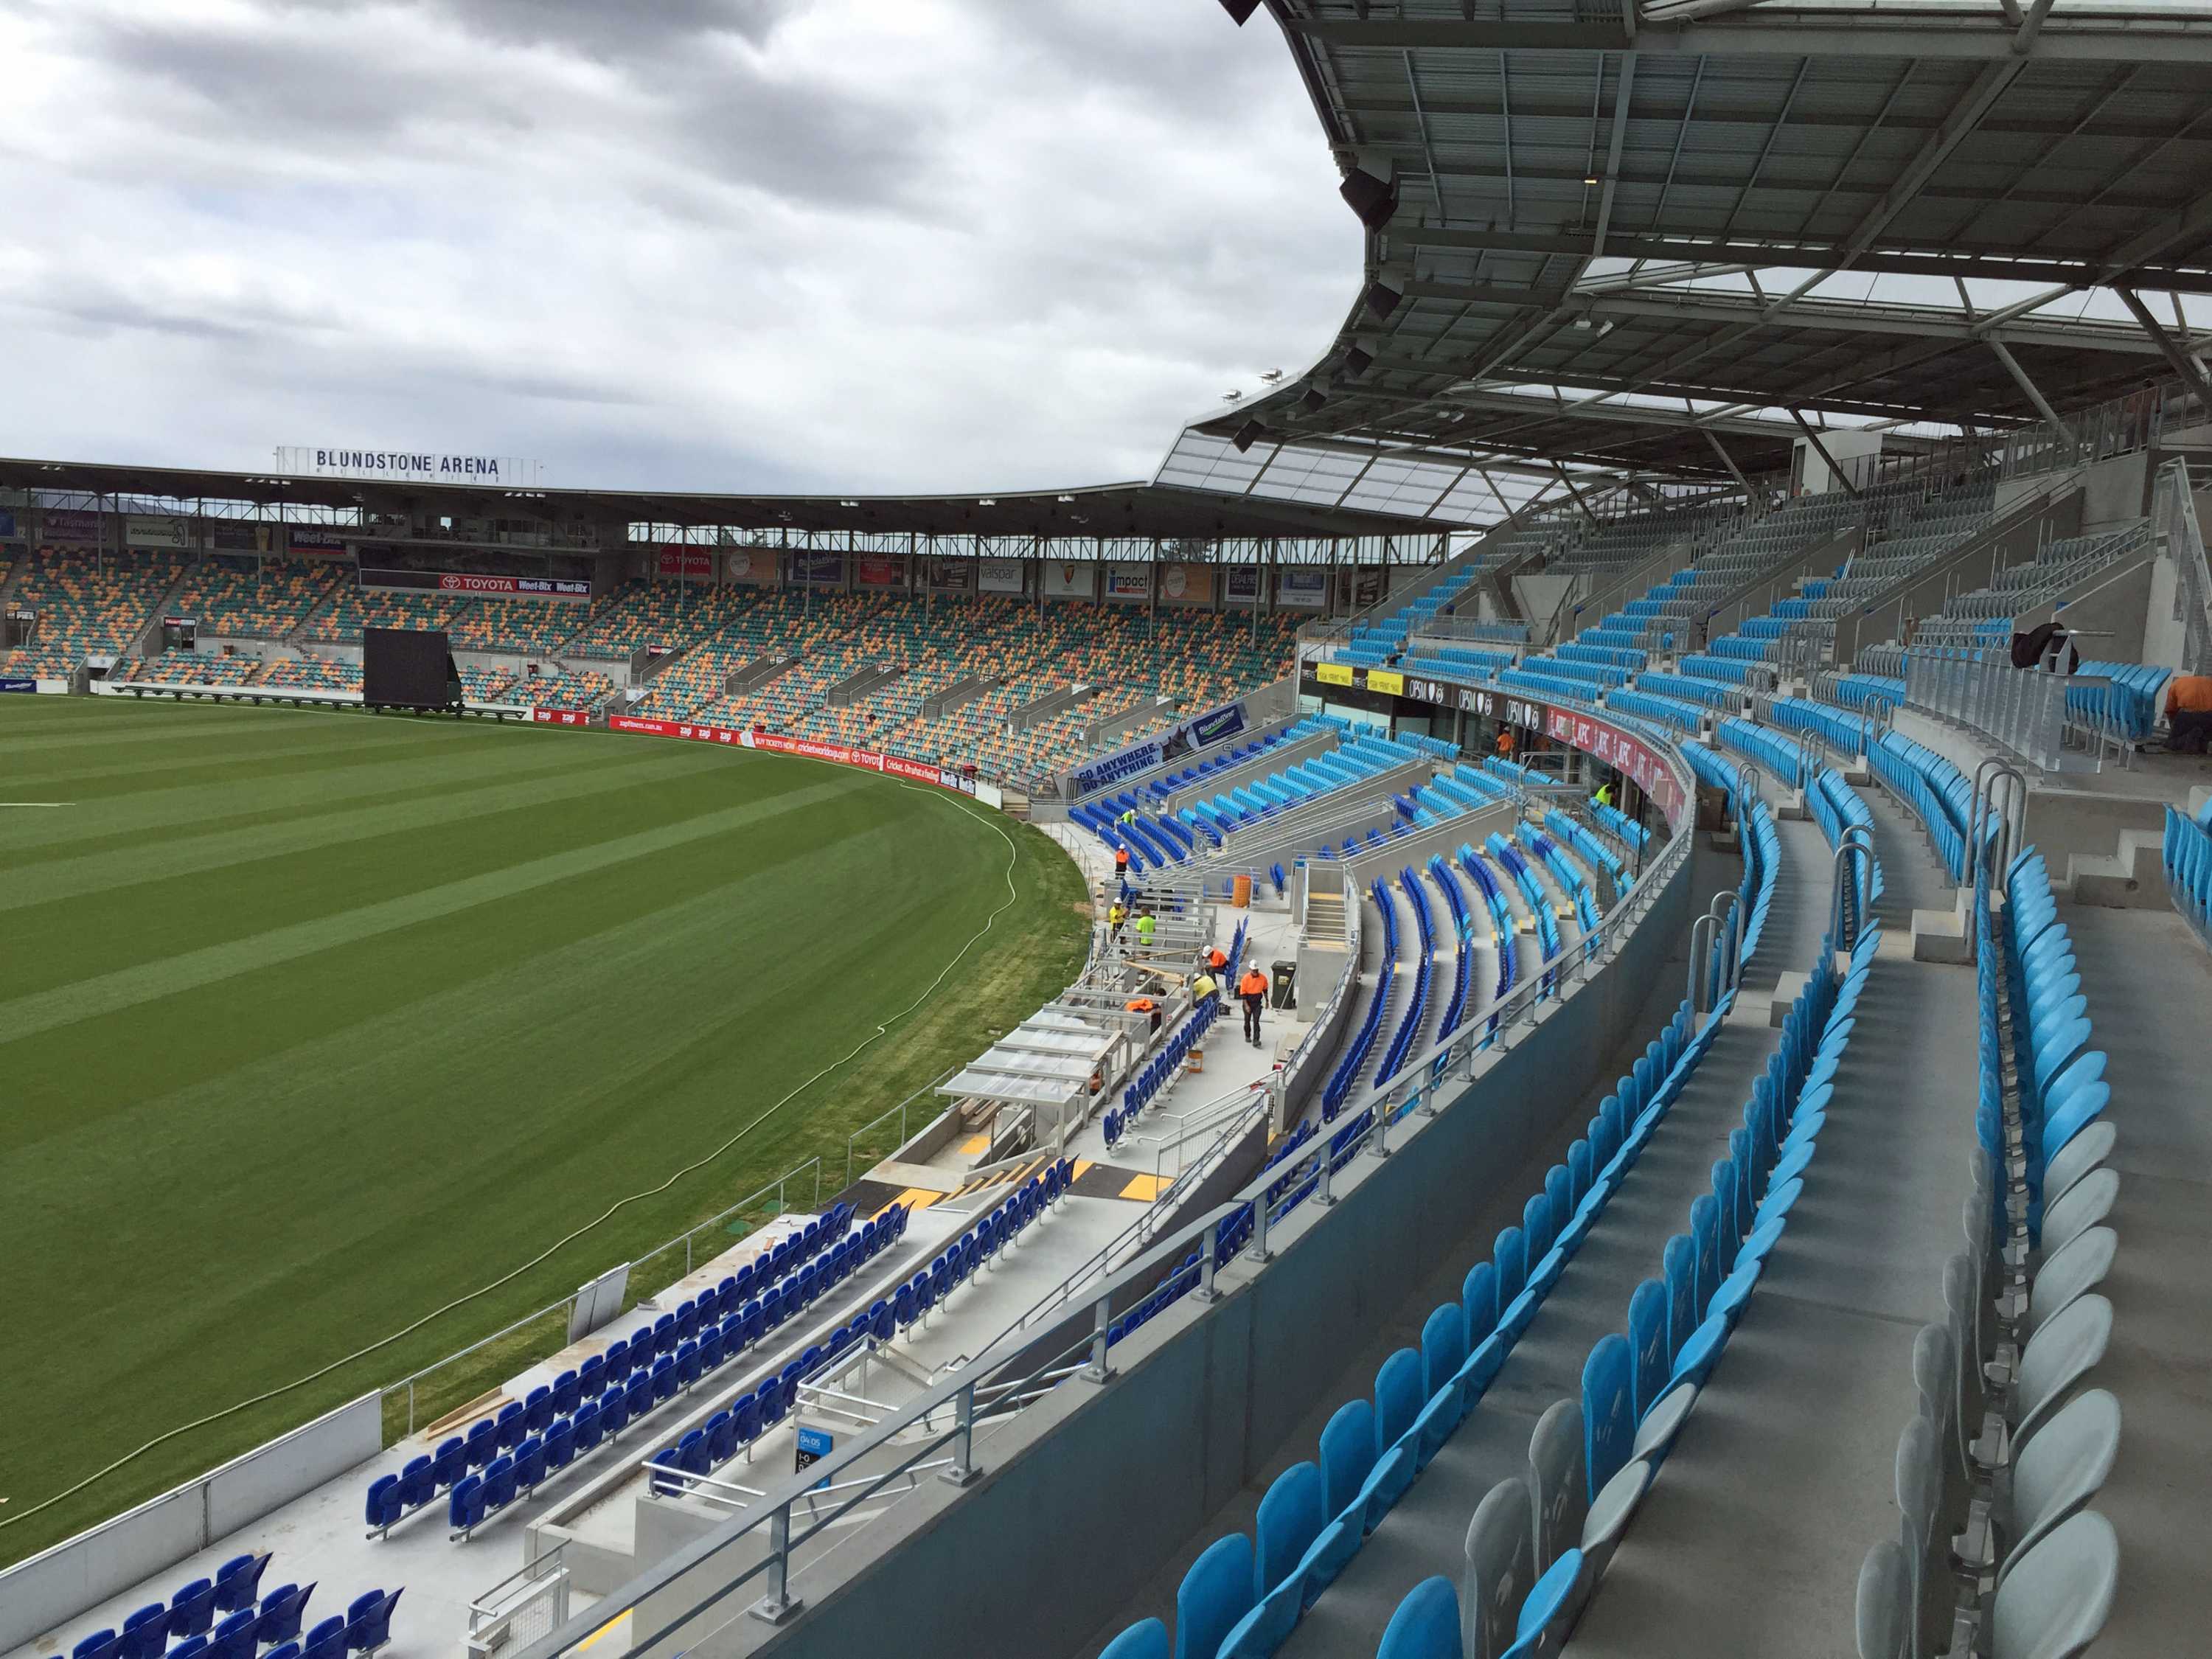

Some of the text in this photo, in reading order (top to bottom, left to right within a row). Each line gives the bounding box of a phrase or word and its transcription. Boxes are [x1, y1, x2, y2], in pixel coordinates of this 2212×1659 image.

[317, 451, 499, 475] BLUNDSTONE ARENA
[59, 517, 106, 529] Tasmana
[676, 557, 710, 566] TOYOTA
[464, 578, 513, 591] TOYOTA
[981, 566, 1016, 582] valspar
[1108, 566, 1147, 592] impact
[519, 580, 552, 591] Weet-Bix
[557, 582, 588, 593] Weet-Bix
[1409, 679, 1427, 700] OPSM
[1458, 689, 1475, 713] OPSM
[538, 712, 551, 721] zap
[562, 714, 575, 723] zap
[1198, 709, 1235, 735] Blundstone
[1506, 700, 1524, 726] OPSM
[680, 727, 692, 737] zap
[1577, 722, 1590, 744] KFC
[1078, 742, 1160, 781] GO ANYWHERE.
[1618, 740, 1631, 766] KFC
[1082, 754, 1158, 793] DO ANYTHING.
